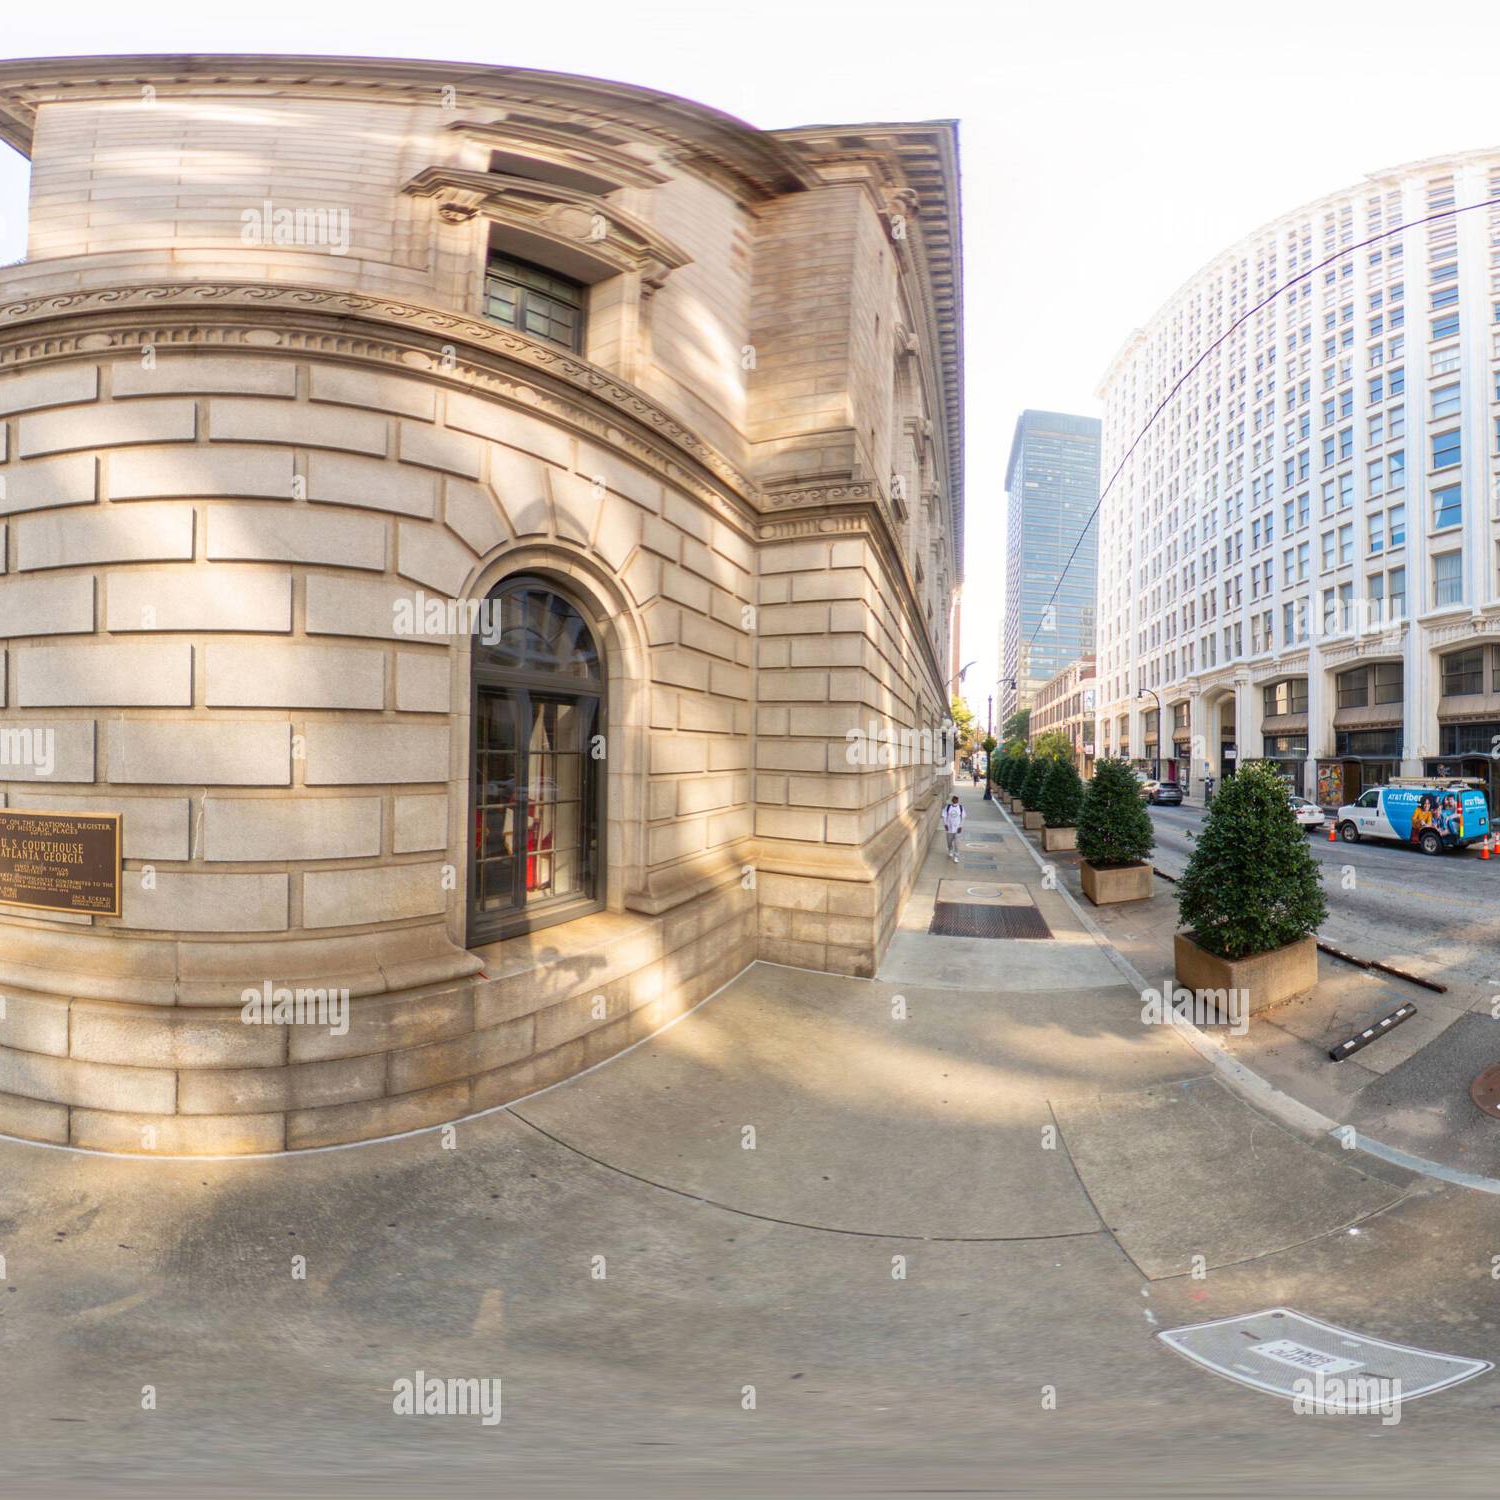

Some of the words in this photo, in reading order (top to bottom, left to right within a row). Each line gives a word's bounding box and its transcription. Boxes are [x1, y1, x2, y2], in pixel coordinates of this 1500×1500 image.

[1387, 793, 1403, 801] AT&T
[1403, 792, 1424, 802] fiber
[38, 821, 75, 829] NATIONAL
[22, 839, 84, 855] COURTHOUSE
[0, 847, 39, 861] ATLANTA
[43, 851, 84, 865] GEORGIA
